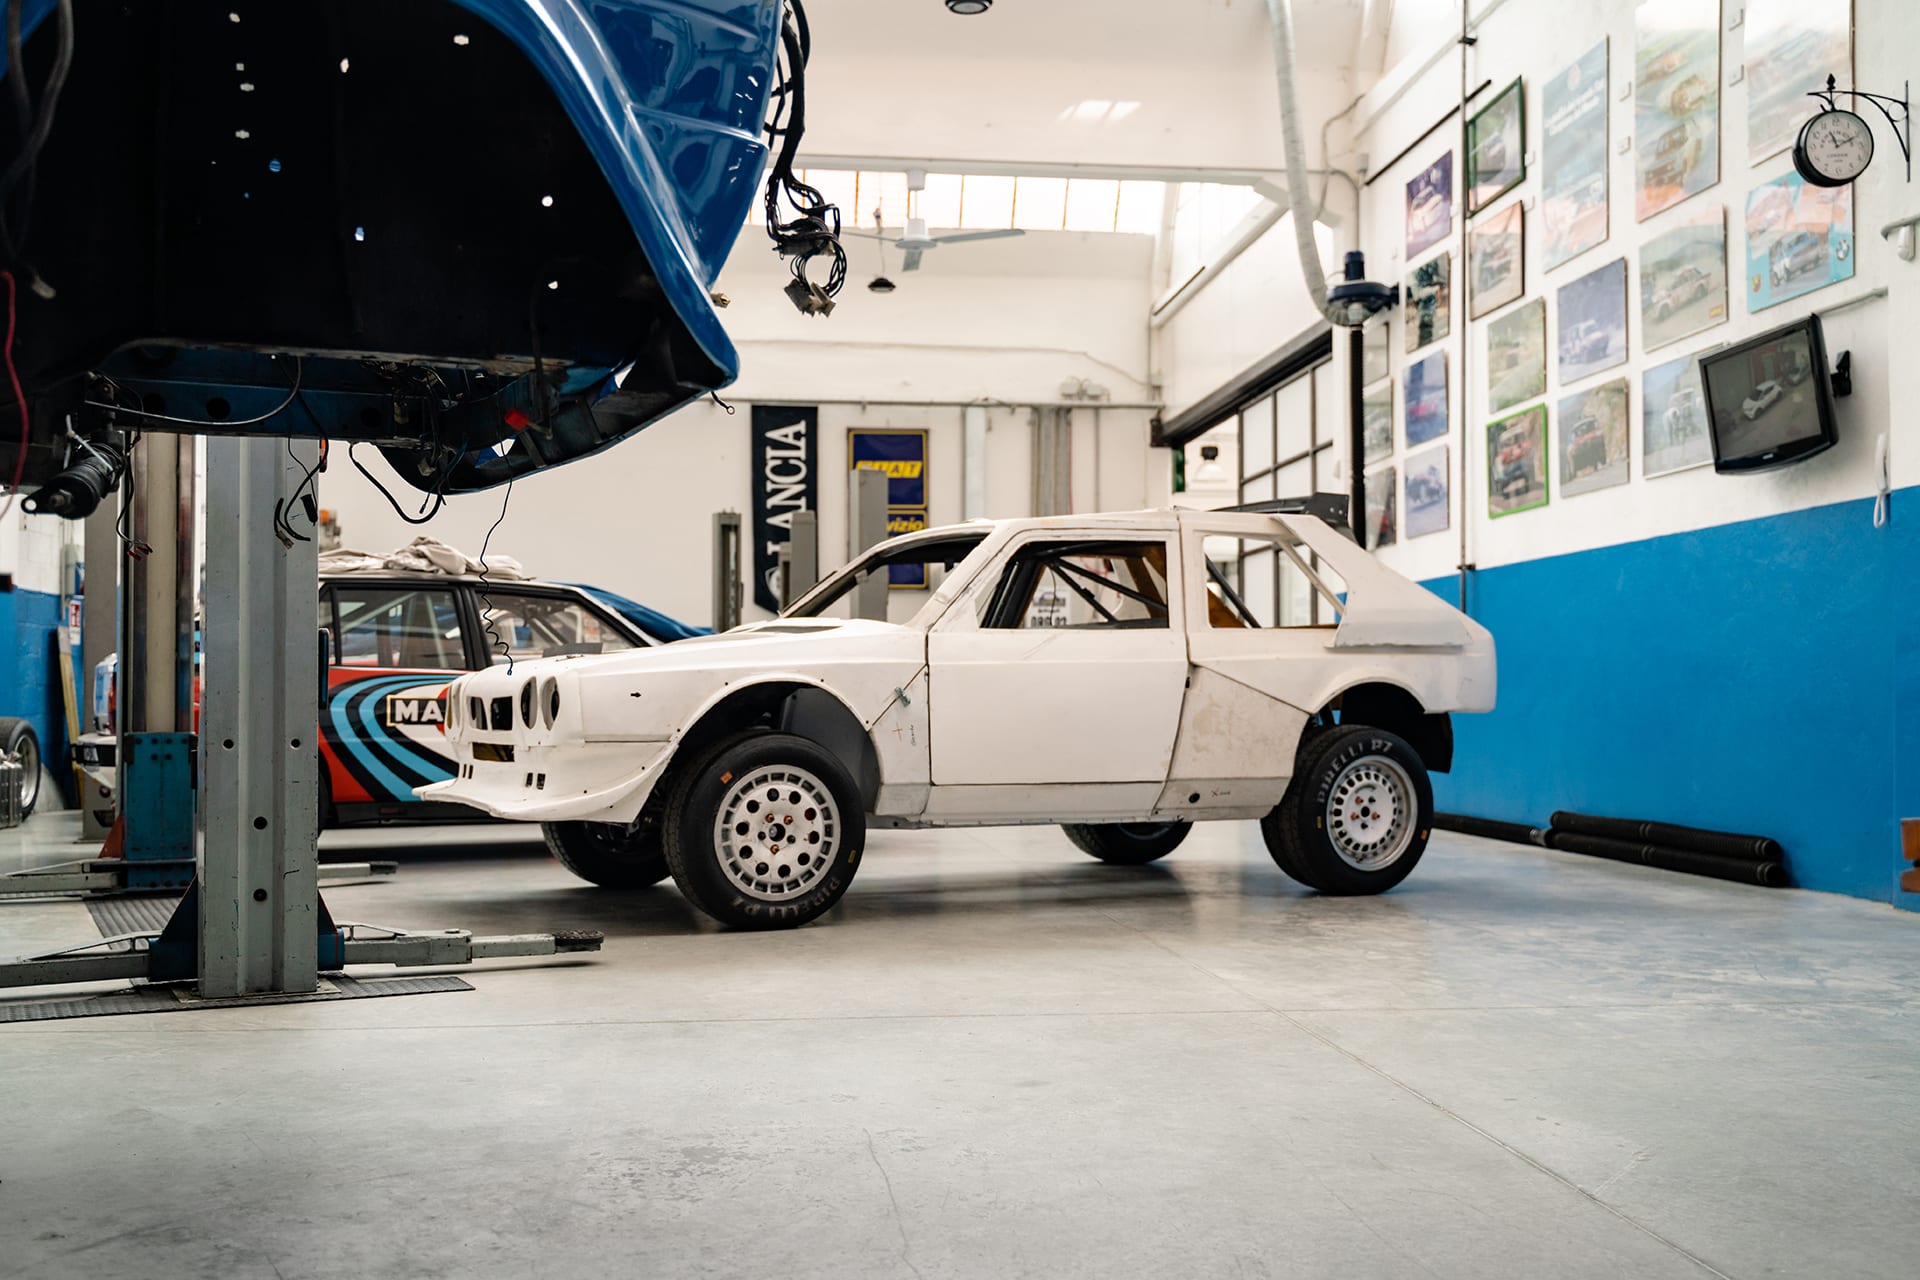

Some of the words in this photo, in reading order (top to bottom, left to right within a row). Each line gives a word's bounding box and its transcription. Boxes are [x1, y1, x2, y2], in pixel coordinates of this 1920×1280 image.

[395, 700, 444, 722] MA
[1317, 742, 1364, 803] PIRELLI
[1371, 739, 1393, 753] P7
